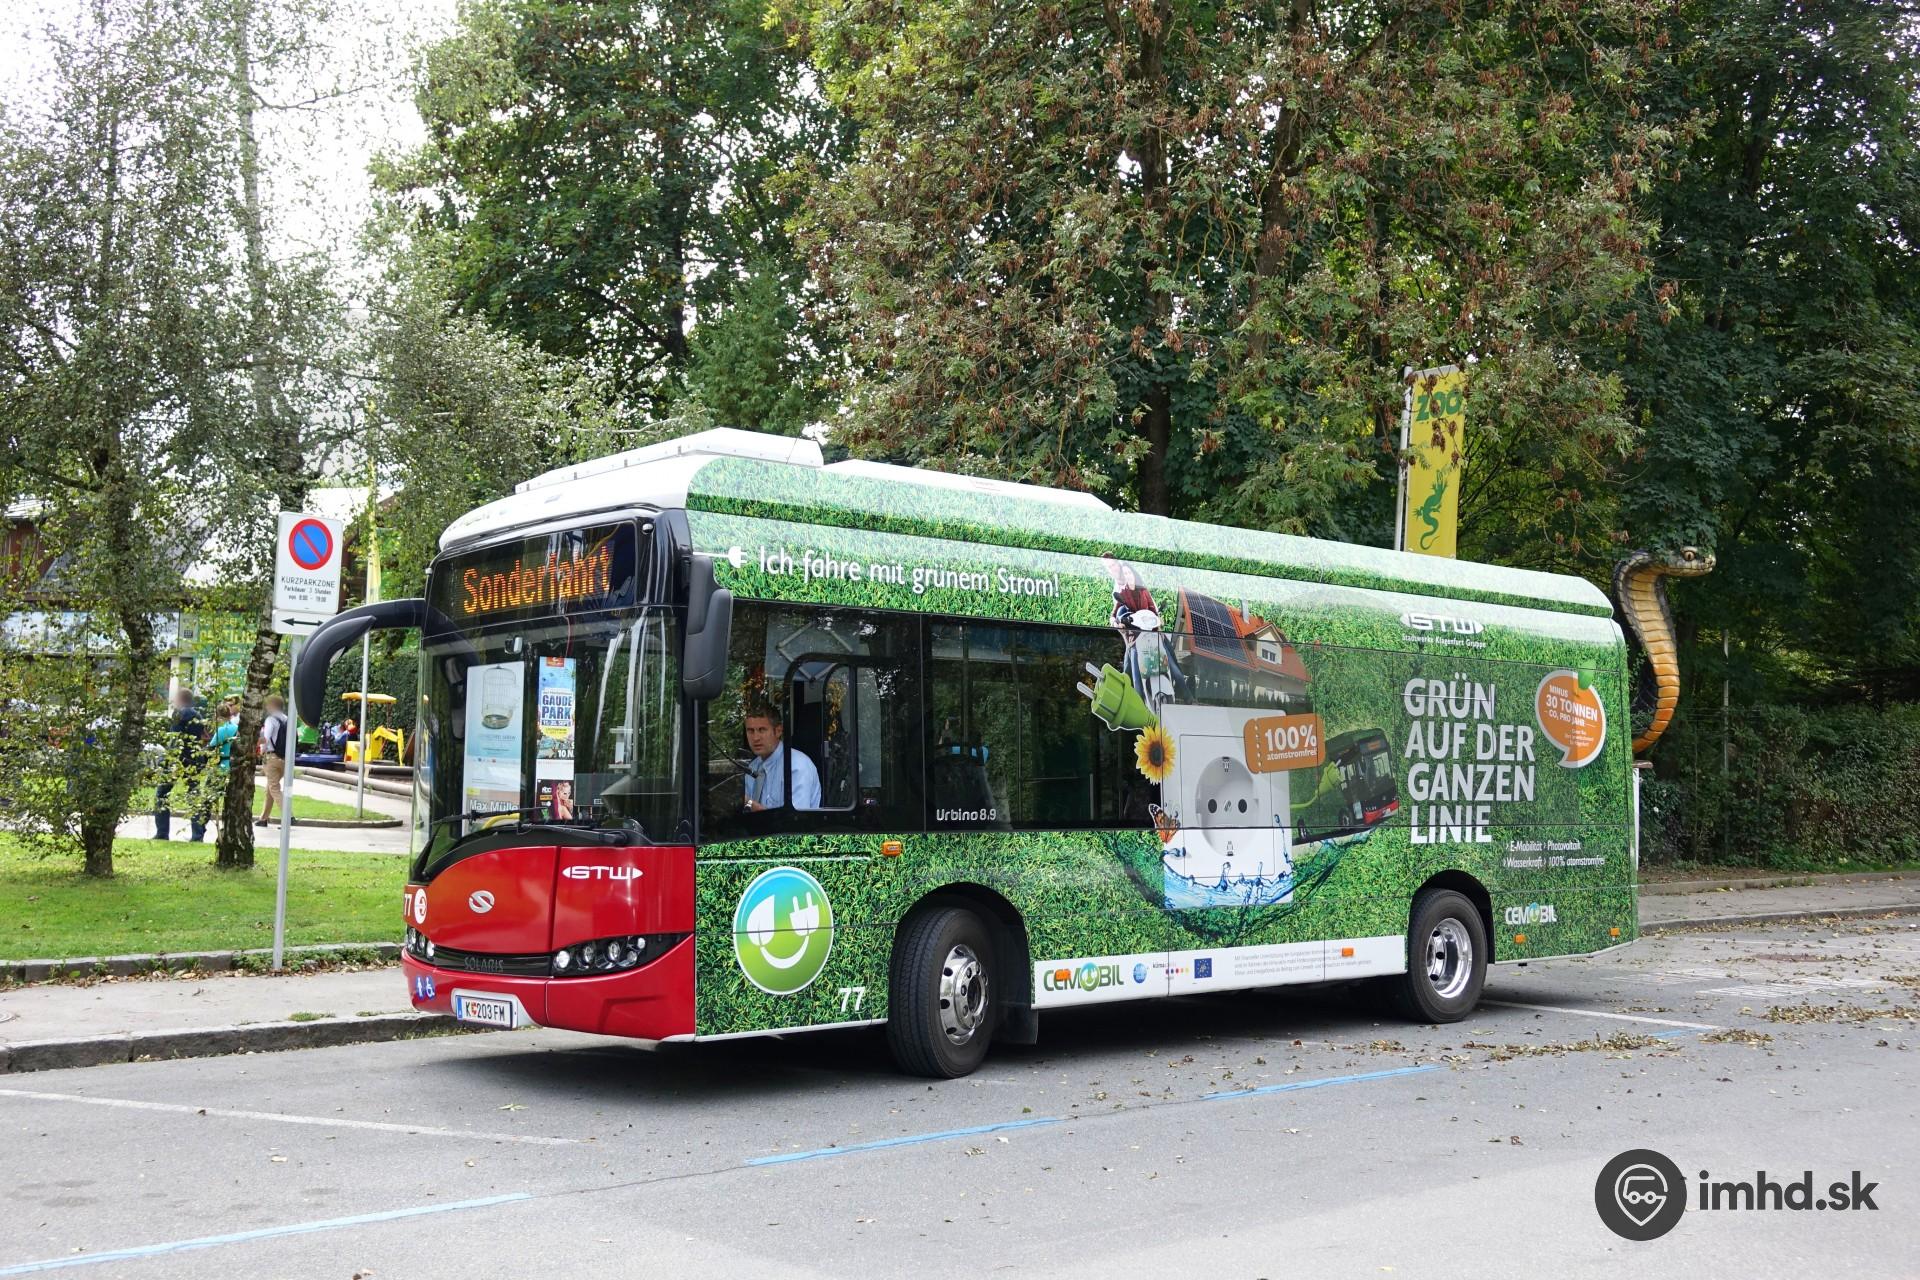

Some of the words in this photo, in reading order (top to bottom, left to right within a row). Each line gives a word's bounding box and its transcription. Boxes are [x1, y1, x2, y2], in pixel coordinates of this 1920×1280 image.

[1416, 389, 1463, 421] ZOO
[281, 576, 336, 588] KURZPARKZONE
[463, 545, 611, 614] Sonderfahrt
[759, 545, 794, 576] Ich
[803, 548, 861, 584] fahre
[869, 563, 905, 585] mit
[912, 567, 990, 595] grünem
[997, 567, 1061, 598] Strom!
[542, 694, 573, 707] GAUDE
[1404, 673, 1495, 720] GRÜN
[1546, 694, 1558, 709] 30
[1560, 697, 1598, 722] TONNEN
[541, 706, 572, 720] PARK
[1265, 724, 1317, 752] 100%
[1405, 720, 1466, 760] AUF
[1476, 725, 1536, 762] DER
[1266, 747, 1317, 761] atomstromfrei
[1408, 763, 1535, 801] GANZEN
[469, 799, 488, 811] Max
[490, 801, 519, 812] Mülle
[936, 807, 979, 821] Urbino
[1410, 805, 1492, 844] LINIE
[570, 865, 632, 880] STW
[1548, 855, 1566, 867] 100%
[1504, 902, 1558, 925] CEMOBIL
[464, 956, 504, 973] SOLARIS
[465, 1001, 472, 1017] K
[838, 986, 866, 1013] 77
